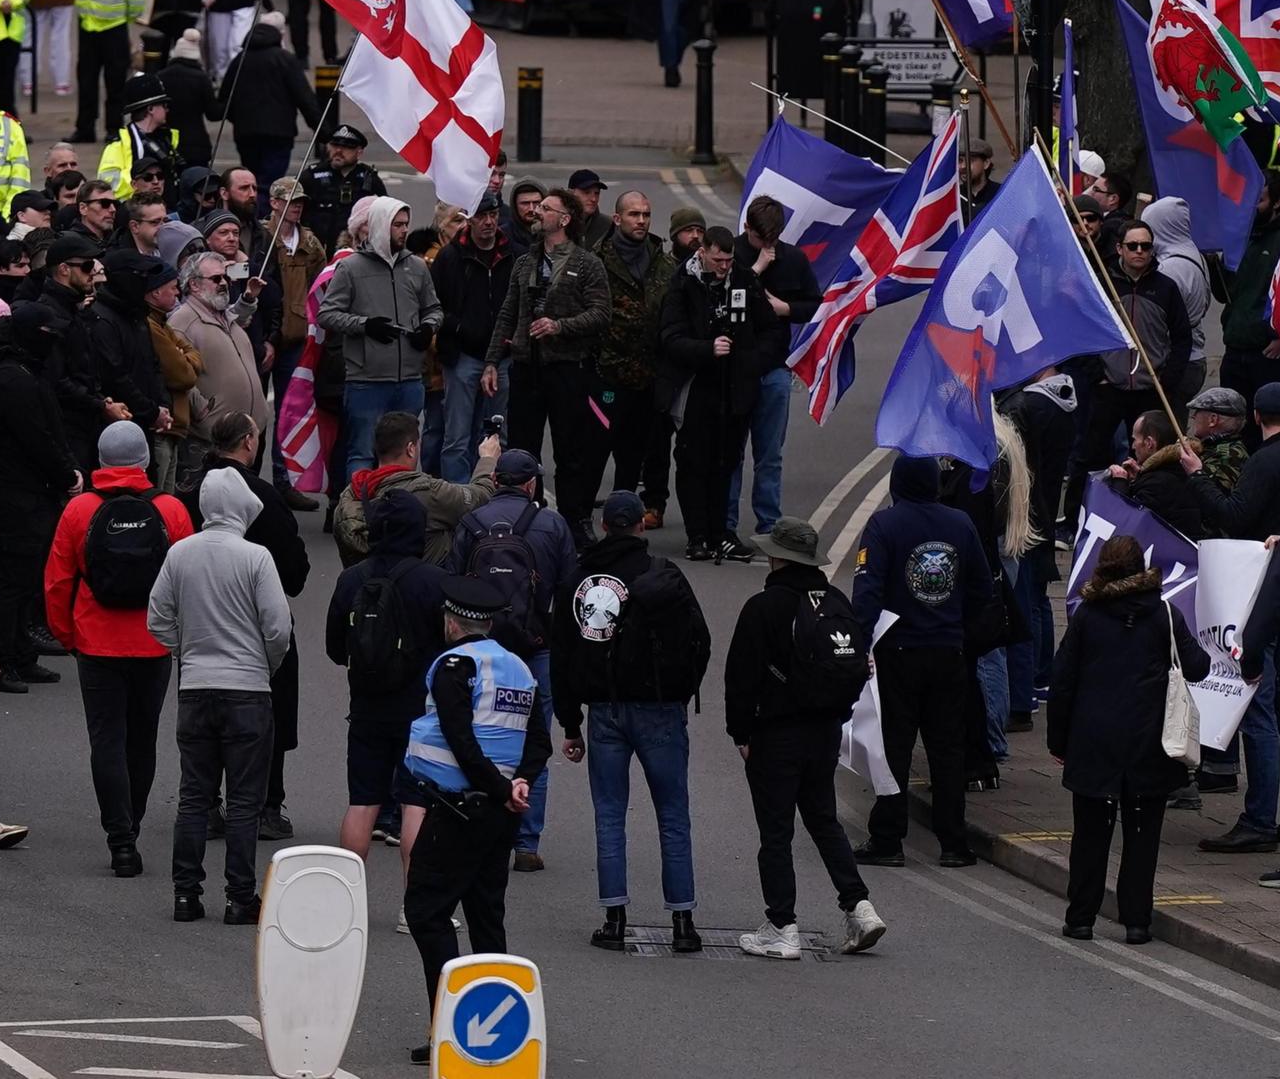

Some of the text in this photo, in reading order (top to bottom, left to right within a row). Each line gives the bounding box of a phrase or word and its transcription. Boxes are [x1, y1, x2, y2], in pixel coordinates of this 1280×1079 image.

[874, 51, 947, 60] PEDESTRIANS
[833, 647, 855, 655] adidas
[497, 690, 532, 706] POLICE
